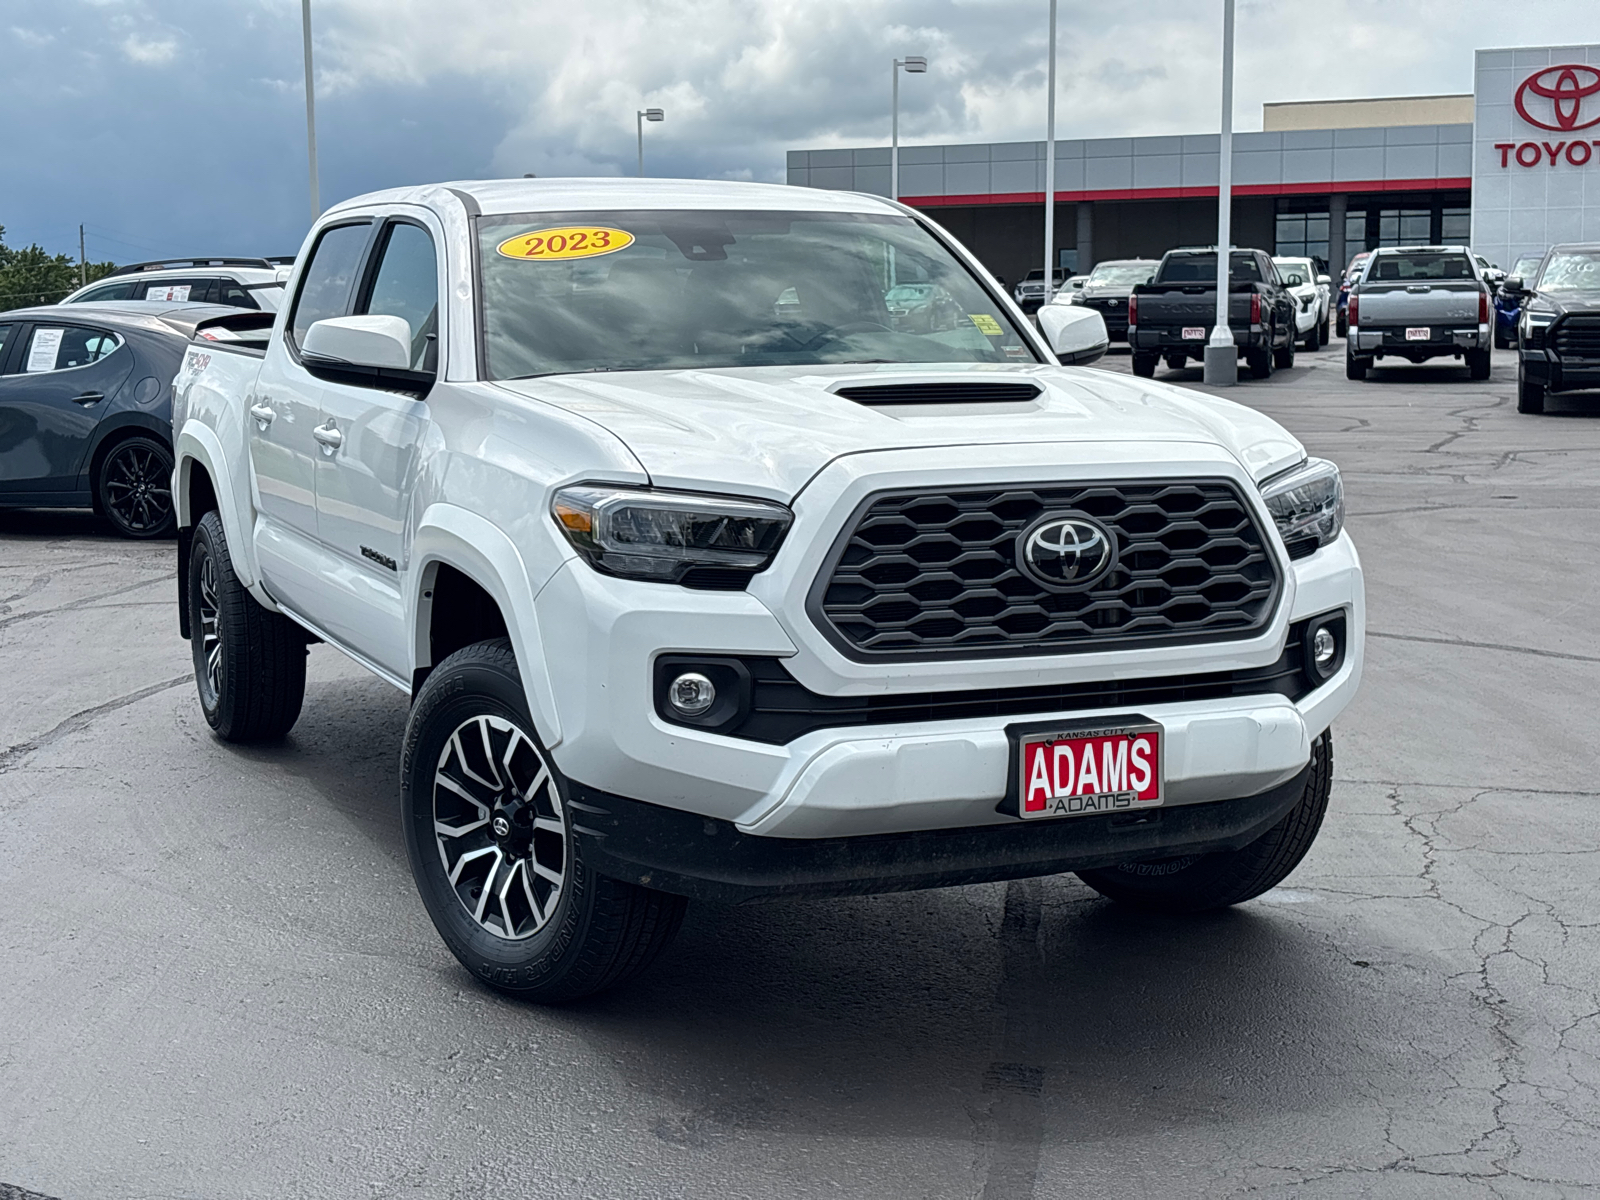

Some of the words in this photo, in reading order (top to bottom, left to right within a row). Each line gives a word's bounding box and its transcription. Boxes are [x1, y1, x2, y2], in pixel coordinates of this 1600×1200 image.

[1494, 140, 1600, 168] TOYO
[525, 230, 611, 256] 2023
[1056, 730, 1100, 740] KANSAS
[1103, 727, 1126, 737] CITY
[1027, 738, 1152, 802] ADAMS
[1053, 792, 1131, 814] ADAMS
[525, 809, 586, 982] EOLANDAR
